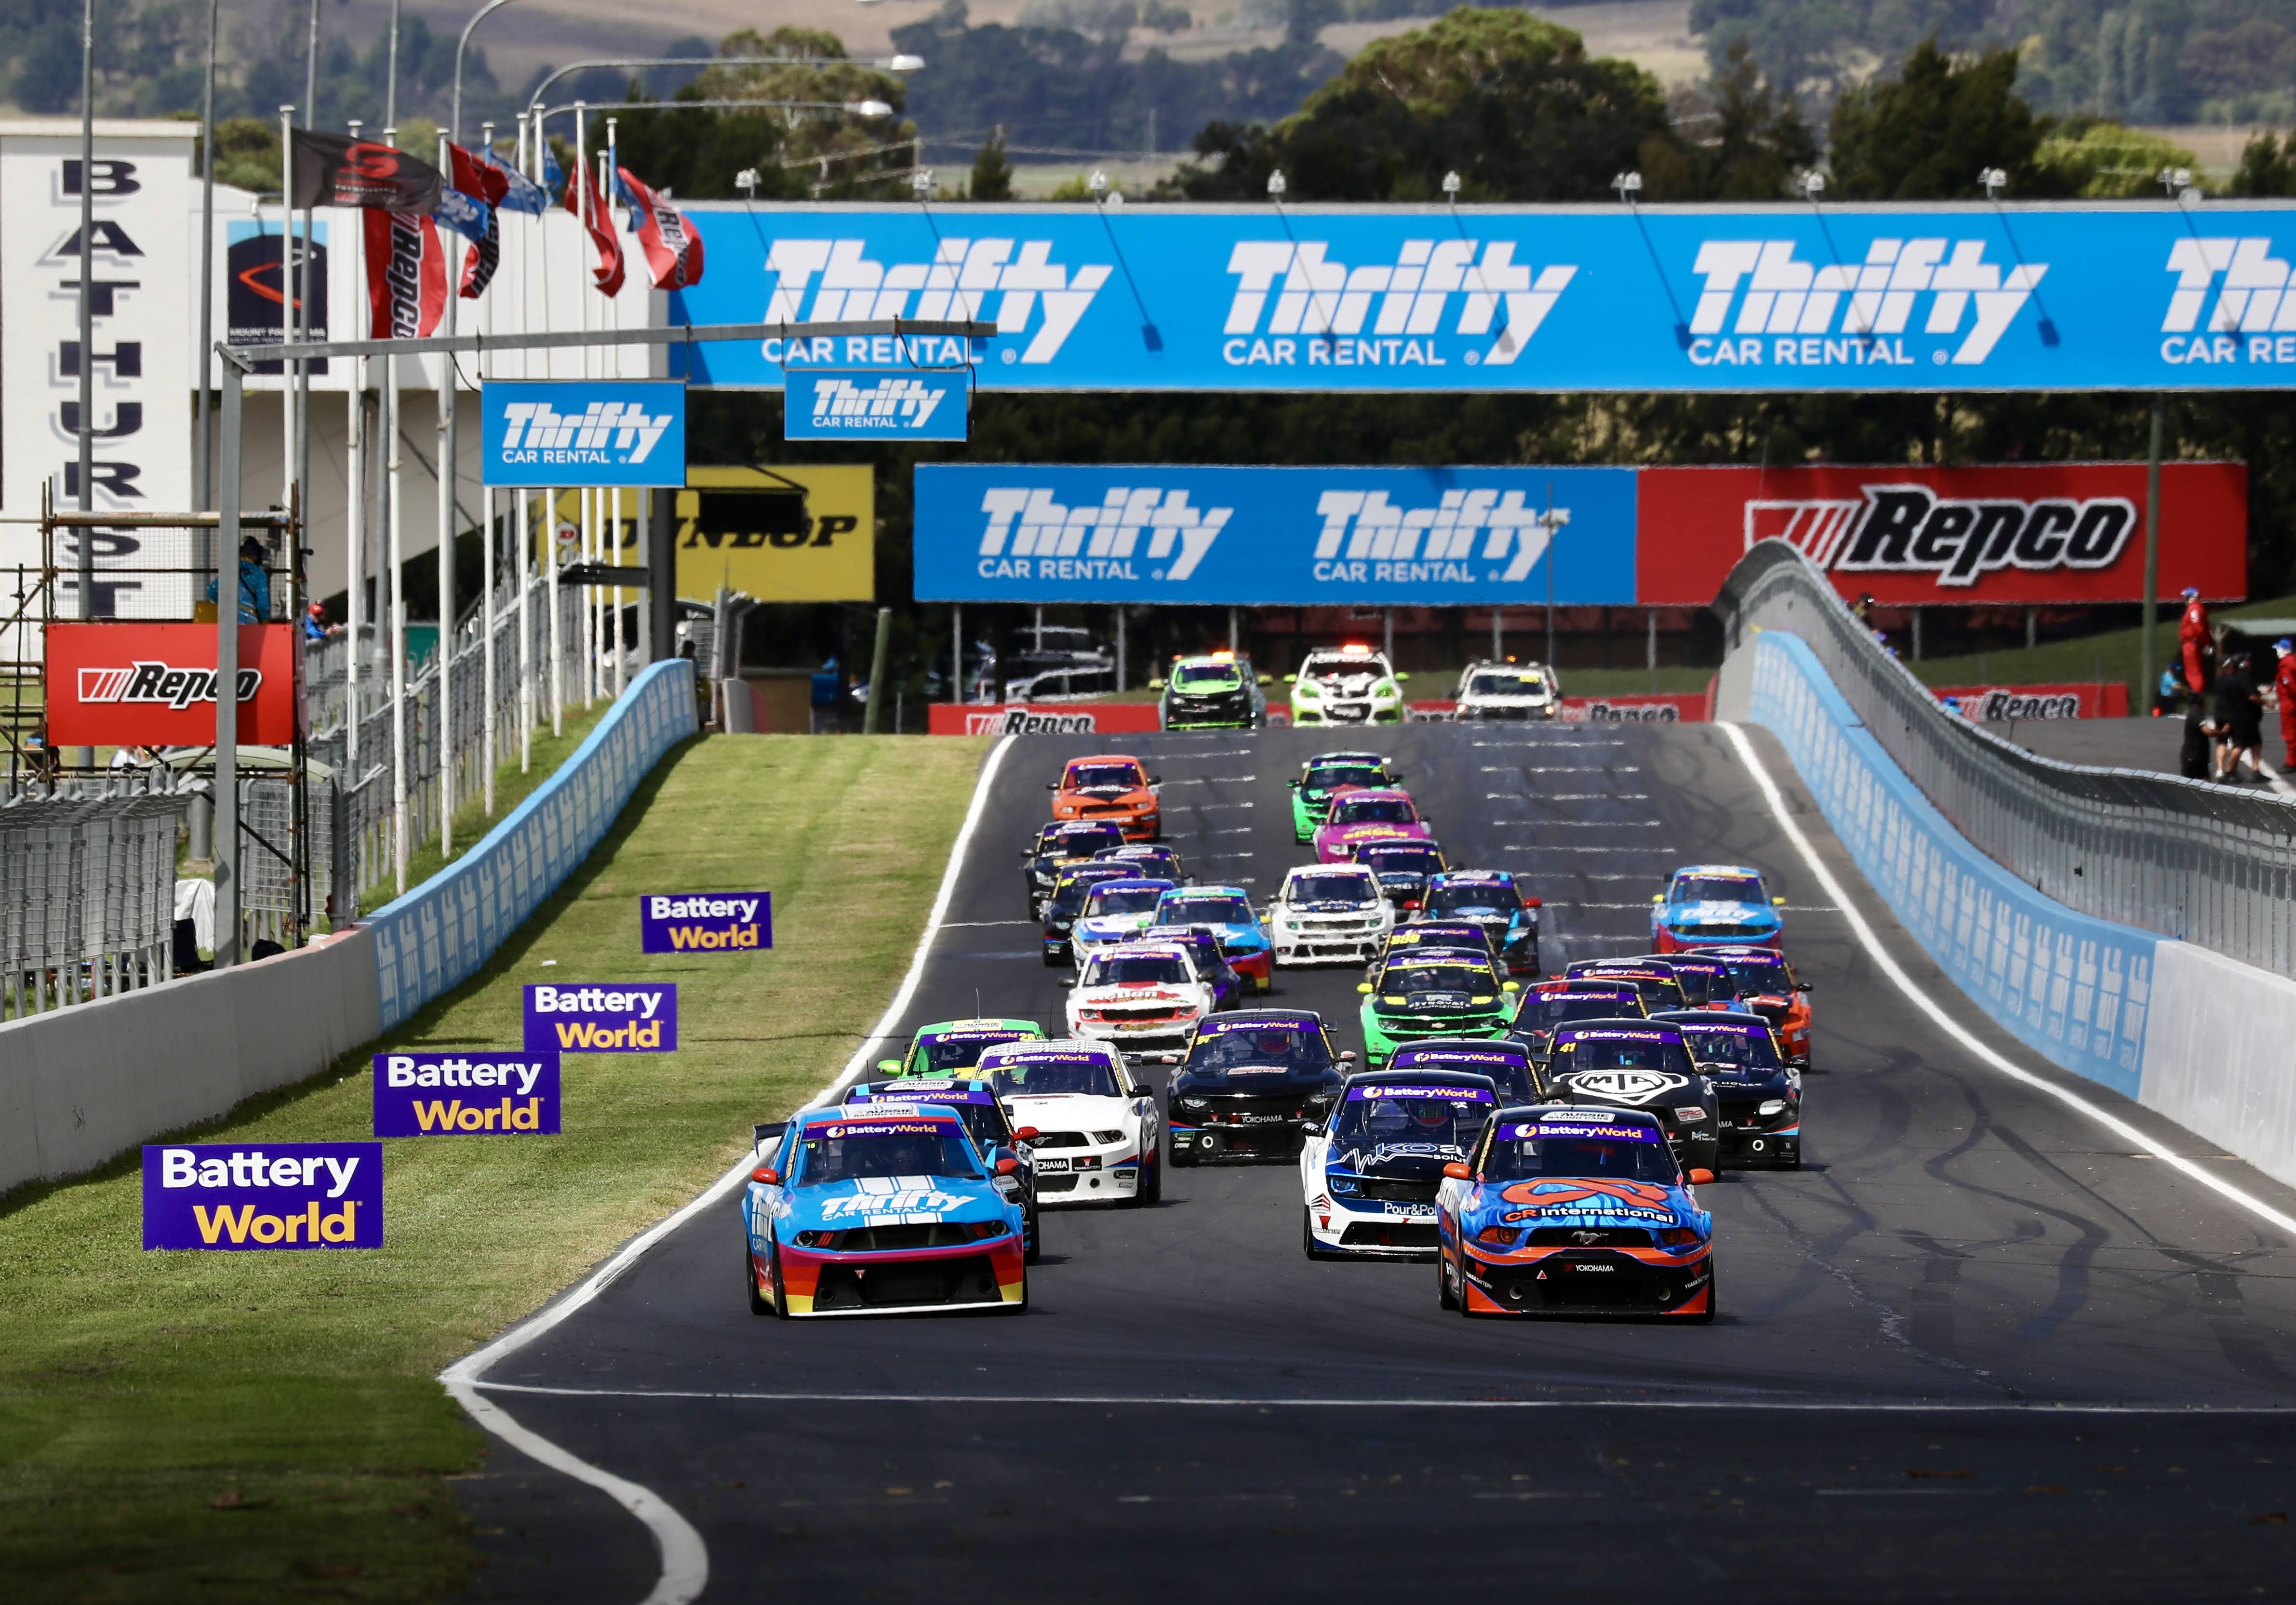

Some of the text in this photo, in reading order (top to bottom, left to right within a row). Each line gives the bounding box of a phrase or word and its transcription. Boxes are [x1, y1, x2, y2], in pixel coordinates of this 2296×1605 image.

[763, 239, 1114, 363] Thrifty
[1223, 239, 1579, 365] Thrifty
[1689, 239, 2050, 364] Thrifty
[761, 338, 983, 363] CAR RENTAL
[1223, 339, 1446, 365] CAR RENTAL
[1688, 339, 1914, 365] CAR RENTAL
[2161, 336, 2236, 363] CAR
[54, 159, 147, 618] BATHURST
[813, 379, 946, 427] Thrifty
[503, 402, 673, 464] Thrifty
[813, 416, 896, 427] CAR RENTAL
[503, 450, 610, 464] CAR RENTAL
[980, 488, 1233, 581] Thrifty
[1316, 489, 1571, 582] Thrifty
[1836, 483, 2137, 586] Repco
[978, 558, 1138, 580] CAR RENTAL
[1314, 561, 1475, 583] CAR RENTAL
[123, 661, 262, 710] Repo
[651, 896, 759, 923] Battery
[669, 923, 759, 949] World
[535, 987, 661, 1018] Battery
[555, 1020, 661, 1048] World
[1019, 1032, 1035, 1041] 28
[1560, 1043, 1576, 1052] 41
[388, 1057, 542, 1095] Battery
[413, 1098, 539, 1131] World
[1241, 1115, 1282, 1123] YOKOHAMA
[162, 1150, 360, 1198] Battery
[821, 1190, 978, 1216] Thrifty
[822, 1207, 922, 1221] CAR RENTAL
[1385, 1203, 1438, 1216] Pour&Pol
[1506, 1208, 1673, 1223] CR International
[194, 1202, 355, 1244] World
